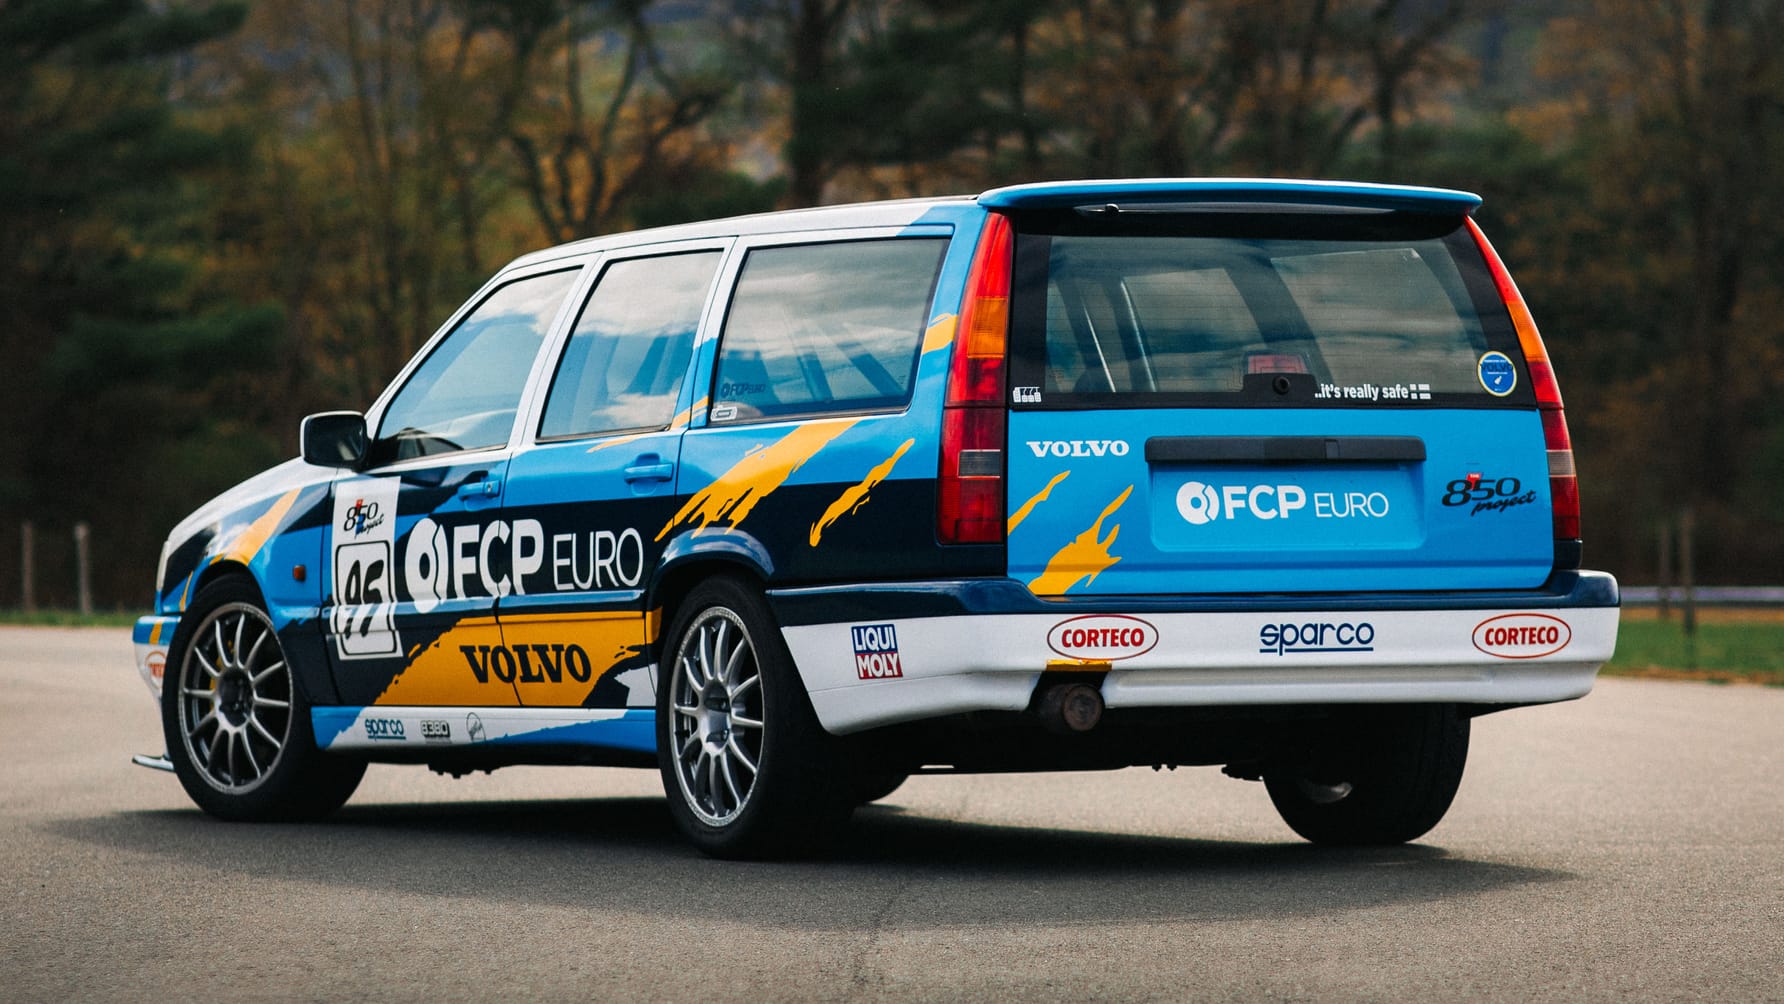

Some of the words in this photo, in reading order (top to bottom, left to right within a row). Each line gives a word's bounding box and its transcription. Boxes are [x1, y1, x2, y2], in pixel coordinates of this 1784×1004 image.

[1344, 384, 1380, 401] really
[1382, 384, 1409, 399] safe
[1026, 440, 1130, 457] VOLVO
[1222, 484, 1307, 519] FCP
[1314, 492, 1389, 518] EURO
[1441, 477, 1521, 507] 850
[1470, 490, 1537, 517] project
[343, 501, 379, 532] 850
[453, 519, 544, 600] FCP
[553, 527, 644, 590] EURO
[853, 626, 896, 651] LIQUI
[1061, 627, 1145, 649] CORTECO
[1260, 623, 1375, 656] sparco
[1485, 626, 1559, 646] CORTECO
[459, 644, 592, 683] VOLVO
[857, 653, 899, 678] MOLY
[365, 719, 405, 741] sparco
